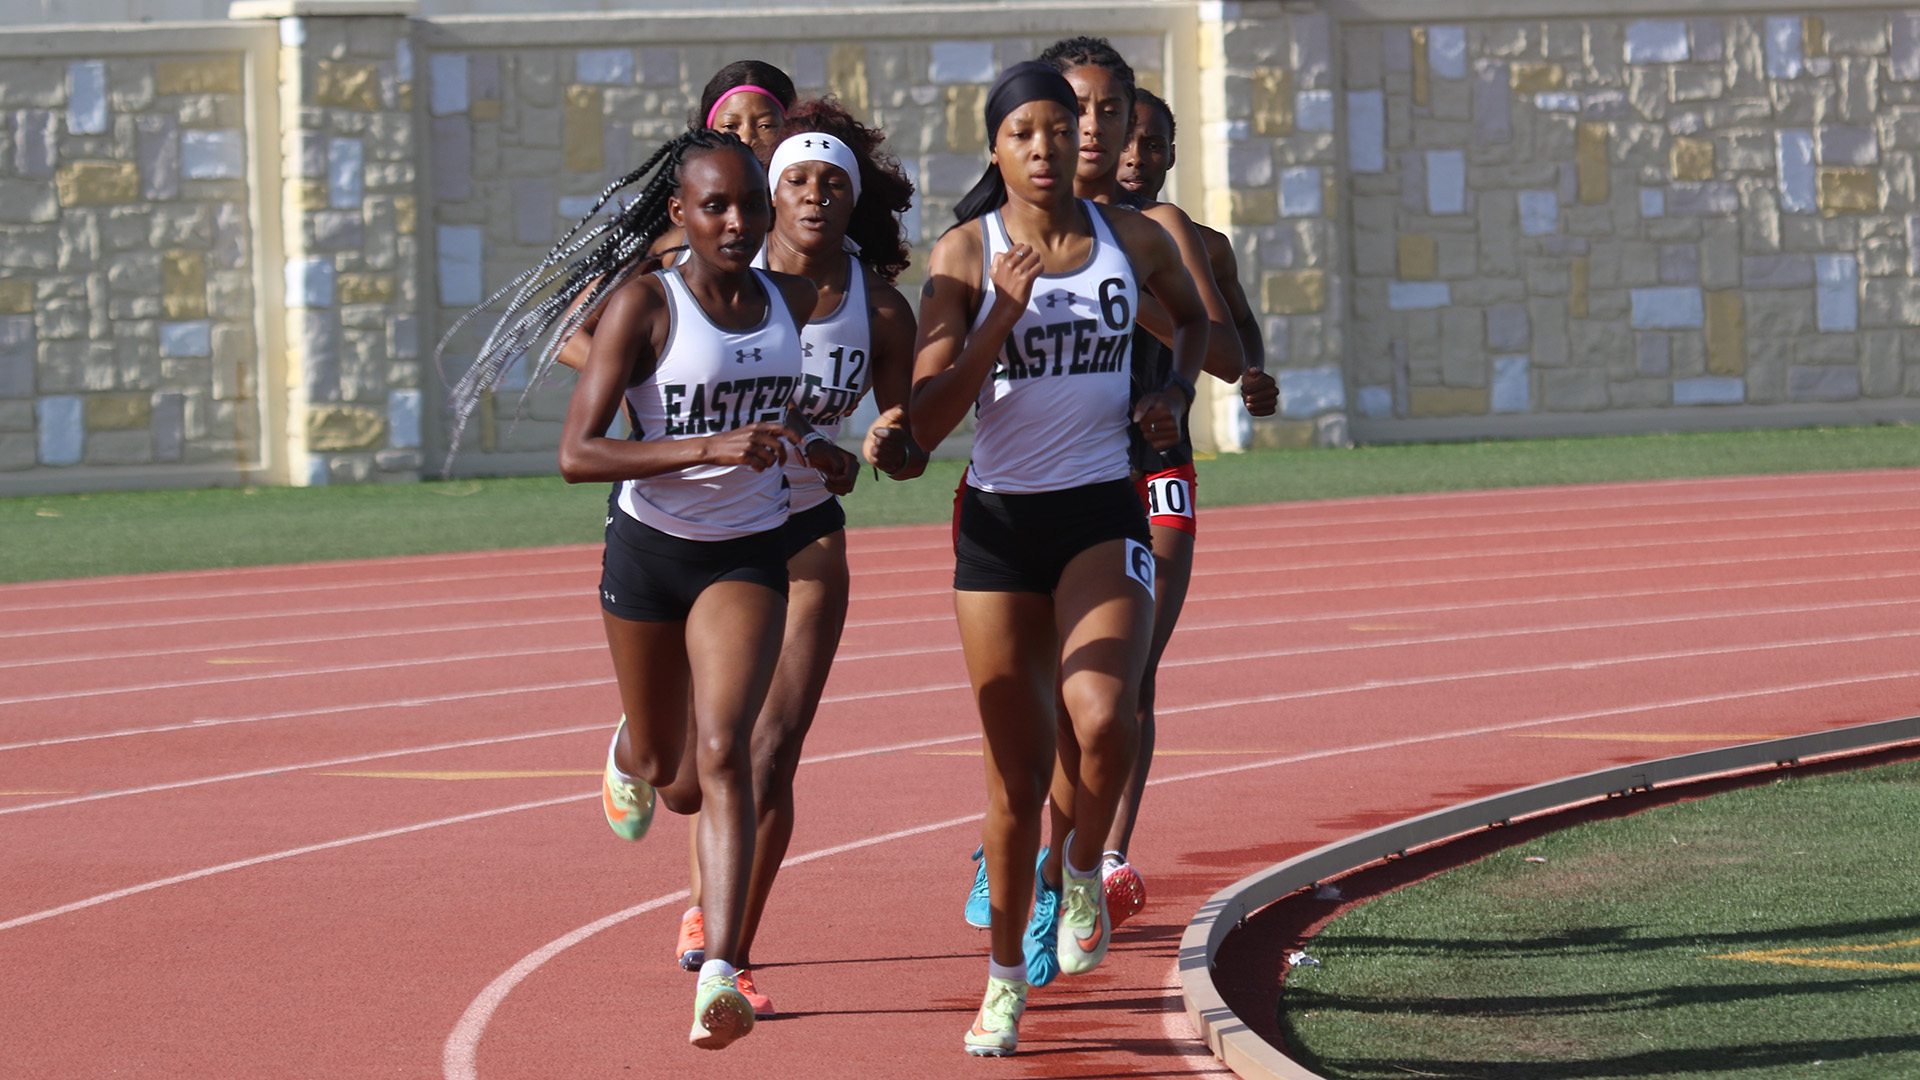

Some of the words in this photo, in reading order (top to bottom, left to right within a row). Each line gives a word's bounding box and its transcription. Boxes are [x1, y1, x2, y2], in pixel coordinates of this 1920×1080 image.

[1098, 278, 1130, 331] 6
[829, 346, 865, 390] 12
[1148, 480, 1185, 514] 10
[1131, 546, 1153, 590] 6
